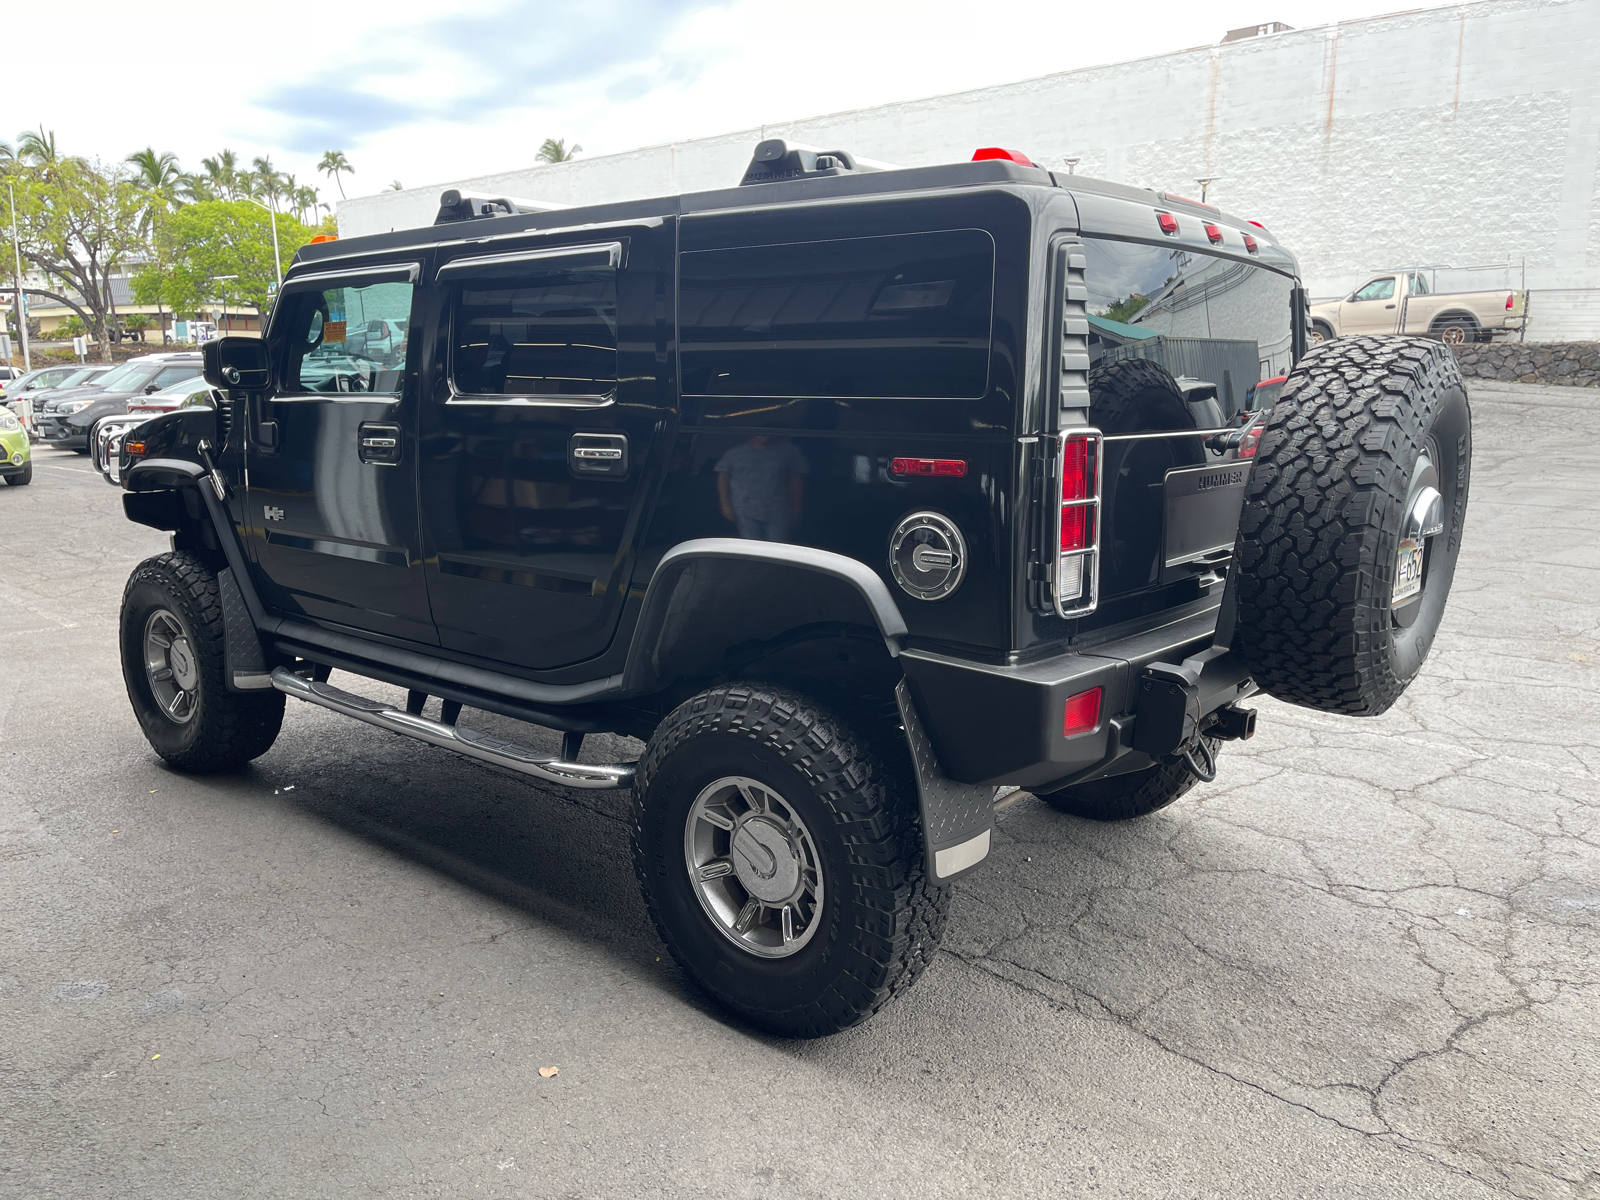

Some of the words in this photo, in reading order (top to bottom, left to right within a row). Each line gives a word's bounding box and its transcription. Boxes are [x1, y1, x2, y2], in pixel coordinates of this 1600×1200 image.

[745, 169, 801, 182] HUMMER
[1198, 471, 1242, 490] HUMMER
[264, 505, 285, 521] H2
